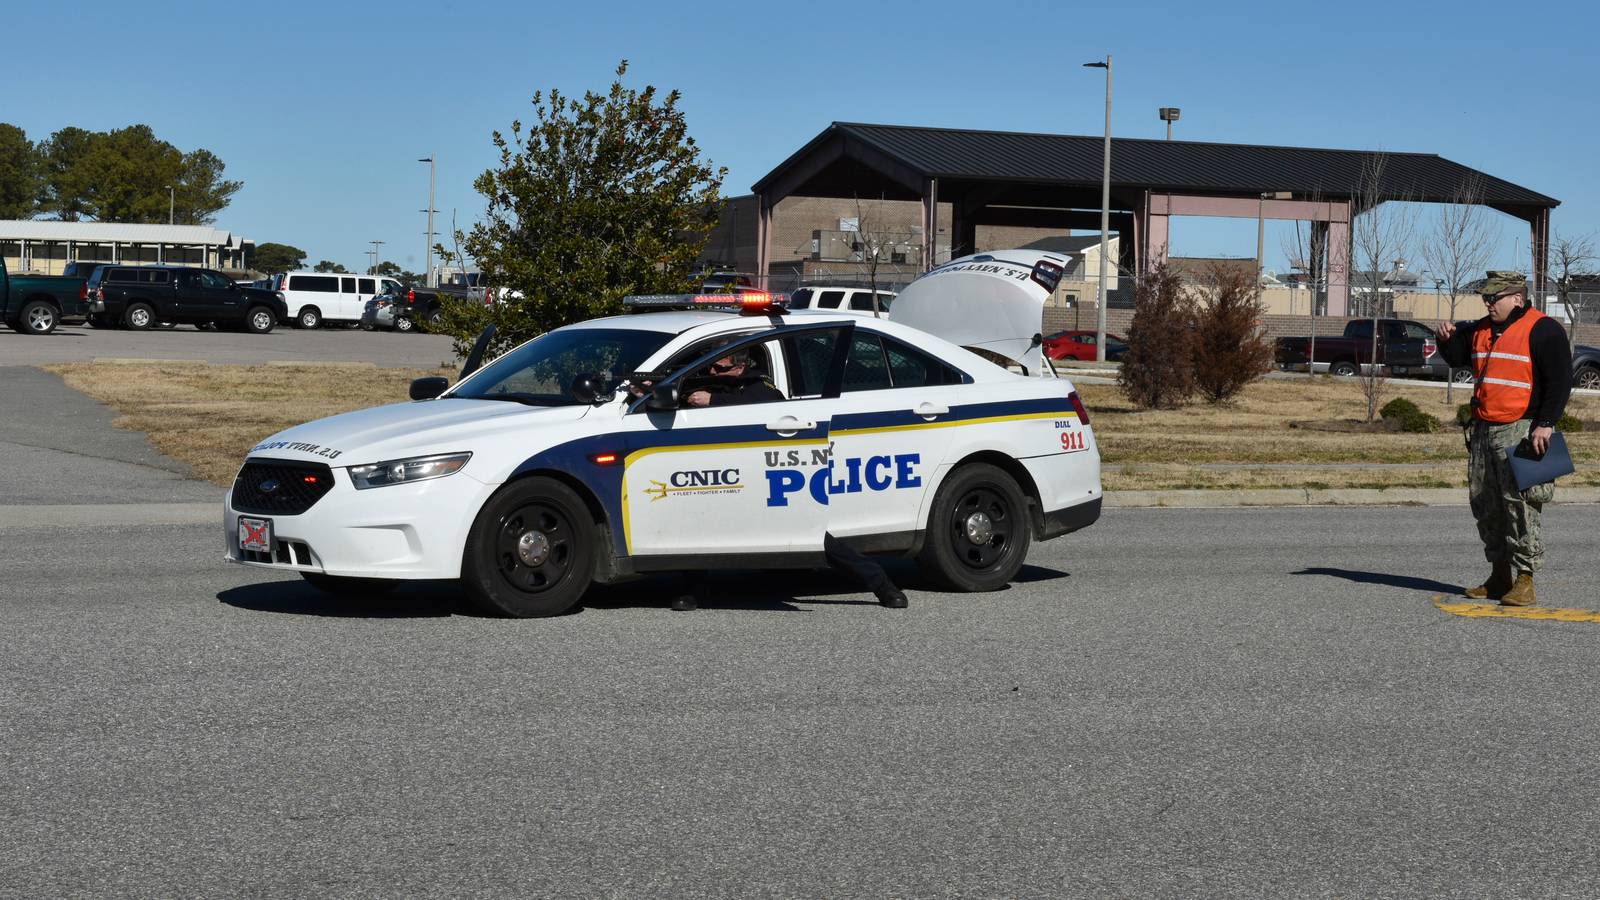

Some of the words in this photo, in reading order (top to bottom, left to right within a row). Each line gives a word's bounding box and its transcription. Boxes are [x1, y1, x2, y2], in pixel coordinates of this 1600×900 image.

[1061, 431, 1084, 450] 911
[764, 450, 807, 467] U.S.
[670, 468, 740, 487] CNIC
